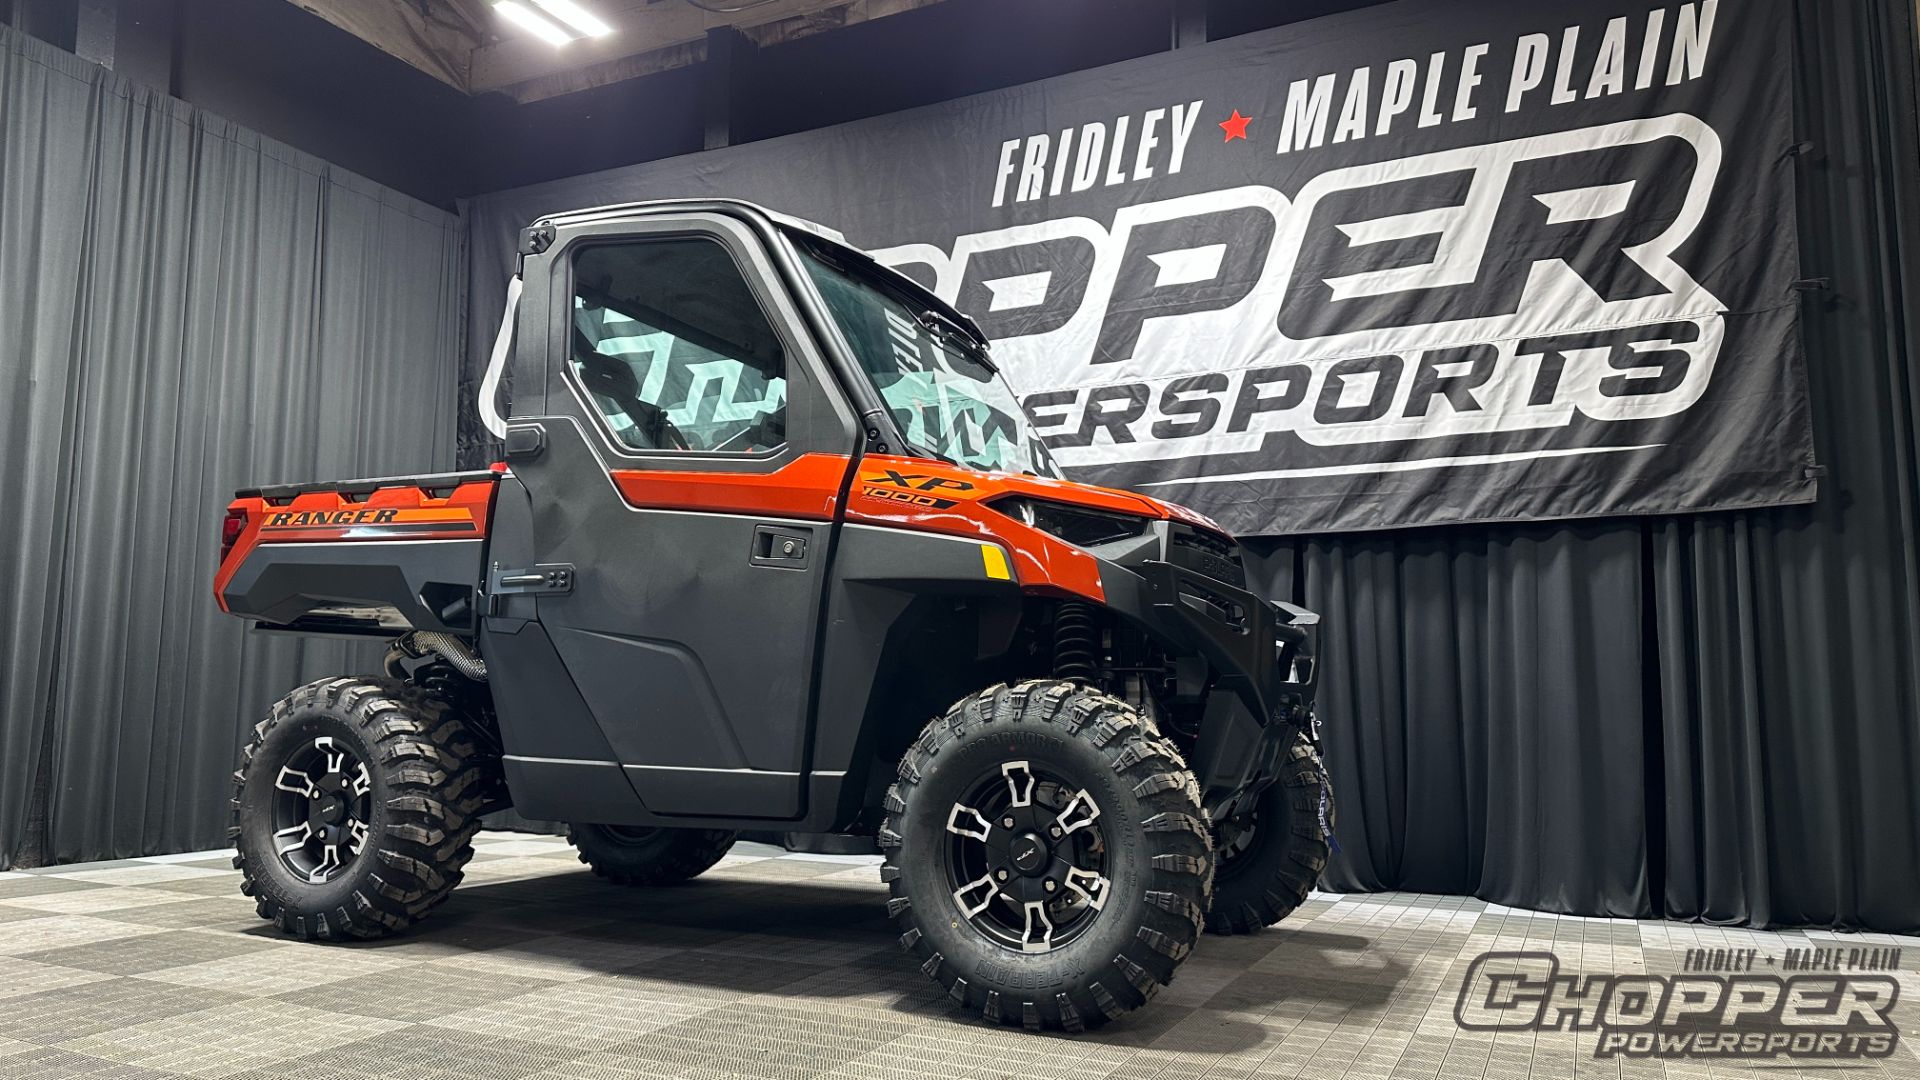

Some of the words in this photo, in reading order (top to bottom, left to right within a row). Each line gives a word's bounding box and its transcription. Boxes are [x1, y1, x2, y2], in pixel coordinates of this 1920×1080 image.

[992, 100, 1203, 207] FRIDLEY
[1277, 42, 1490, 154] MAPLE
[1504, 0, 1719, 113] PLAIN
[865, 469, 974, 491] XP
[863, 486, 937, 507] 1000
[270, 509, 398, 526] RANGER
